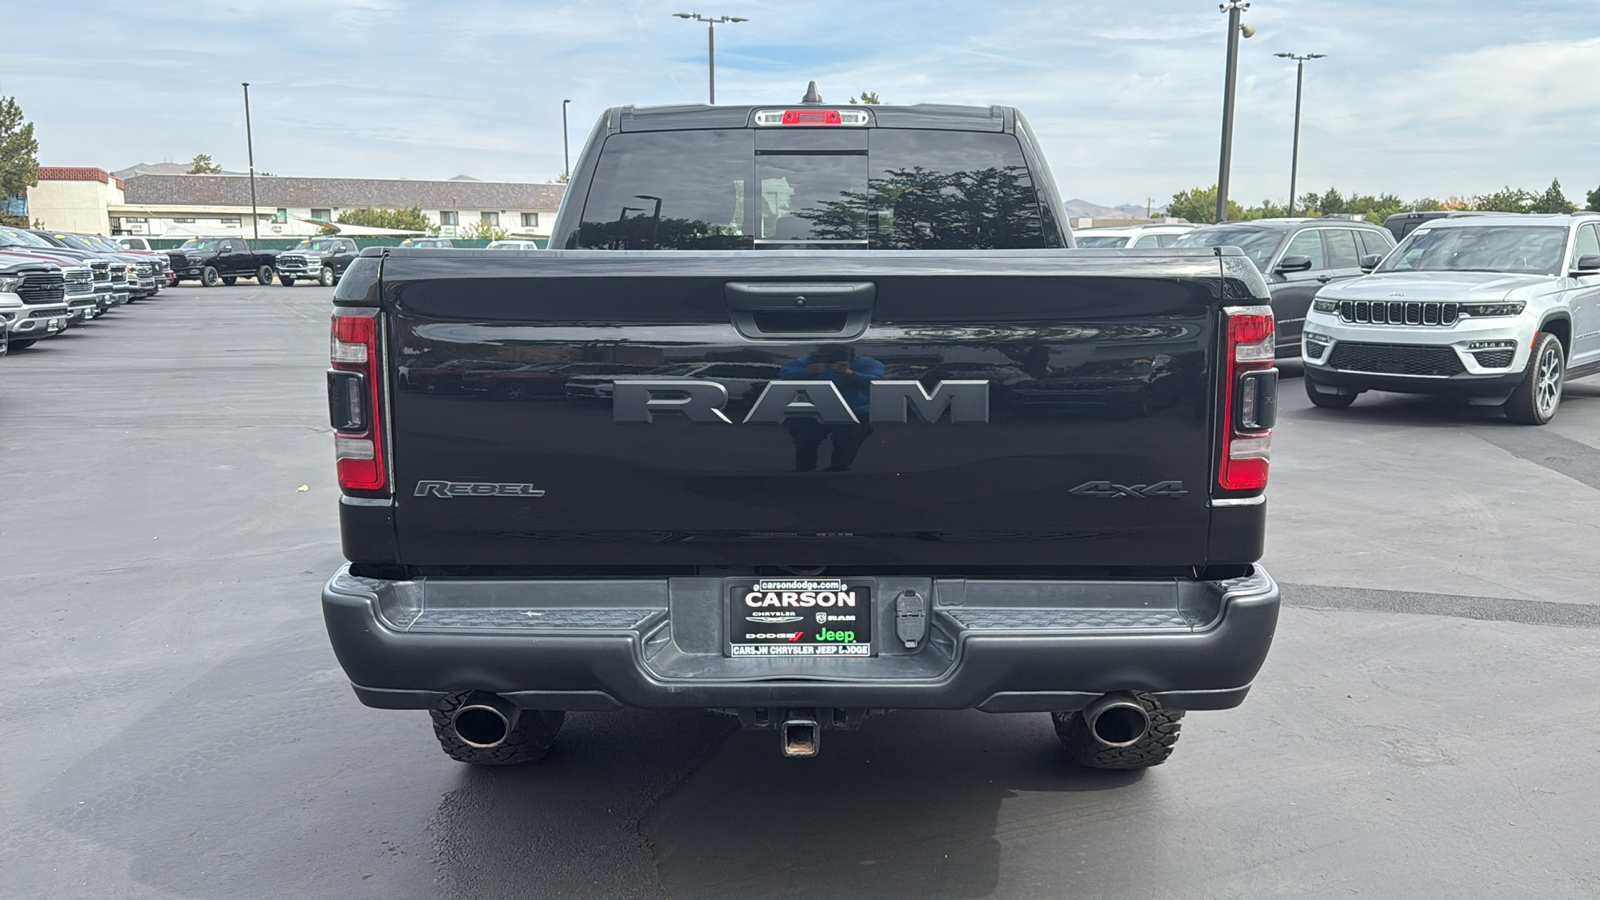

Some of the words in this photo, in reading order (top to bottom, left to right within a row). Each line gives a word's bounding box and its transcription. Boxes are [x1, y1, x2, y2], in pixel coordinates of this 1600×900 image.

[613, 380, 991, 424] RAM
[413, 480, 545, 498] REBEL
[762, 581, 839, 590] carsondodge.com
[745, 592, 856, 607] CARSON
[815, 627, 855, 643] Jeep
[769, 646, 815, 655] CHRYSLER
[815, 646, 837, 655] JEEP
